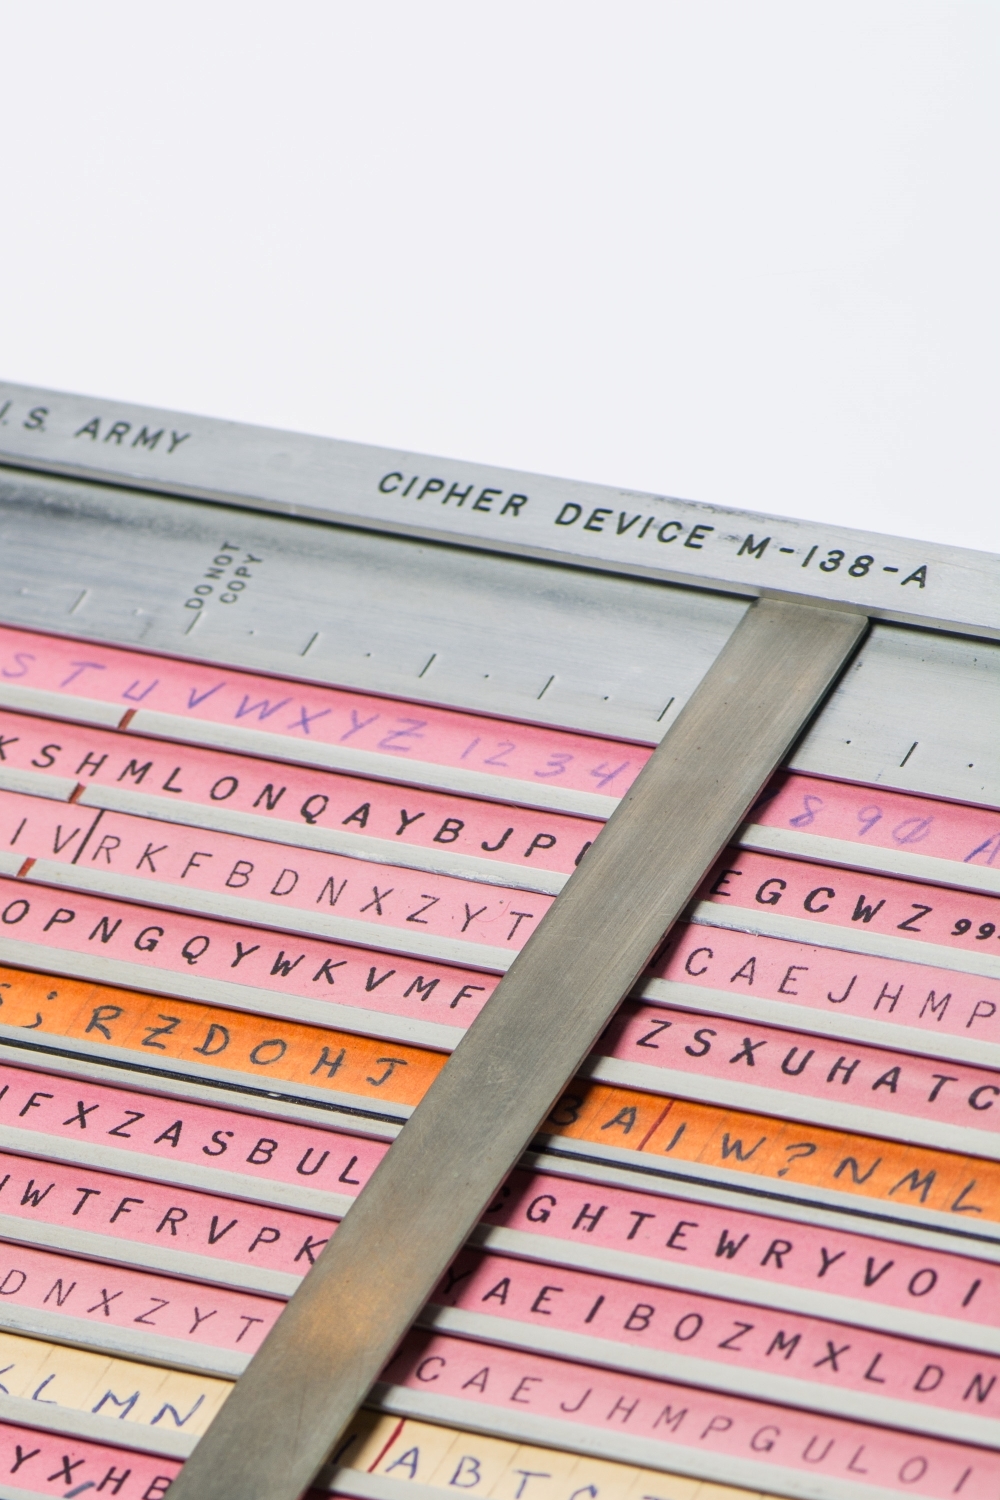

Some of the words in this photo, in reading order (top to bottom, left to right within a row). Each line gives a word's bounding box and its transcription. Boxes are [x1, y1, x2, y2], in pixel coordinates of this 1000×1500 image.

[74, 417, 192, 455] ARMY
[378, 471, 529, 518] CIPHER
[554, 502, 714, 550] DEVICE
[736, 533, 928, 589] M-138-A
[184, 584, 213, 610] DO
[204, 541, 240, 579] NOT
[219, 553, 263, 604] COPY
